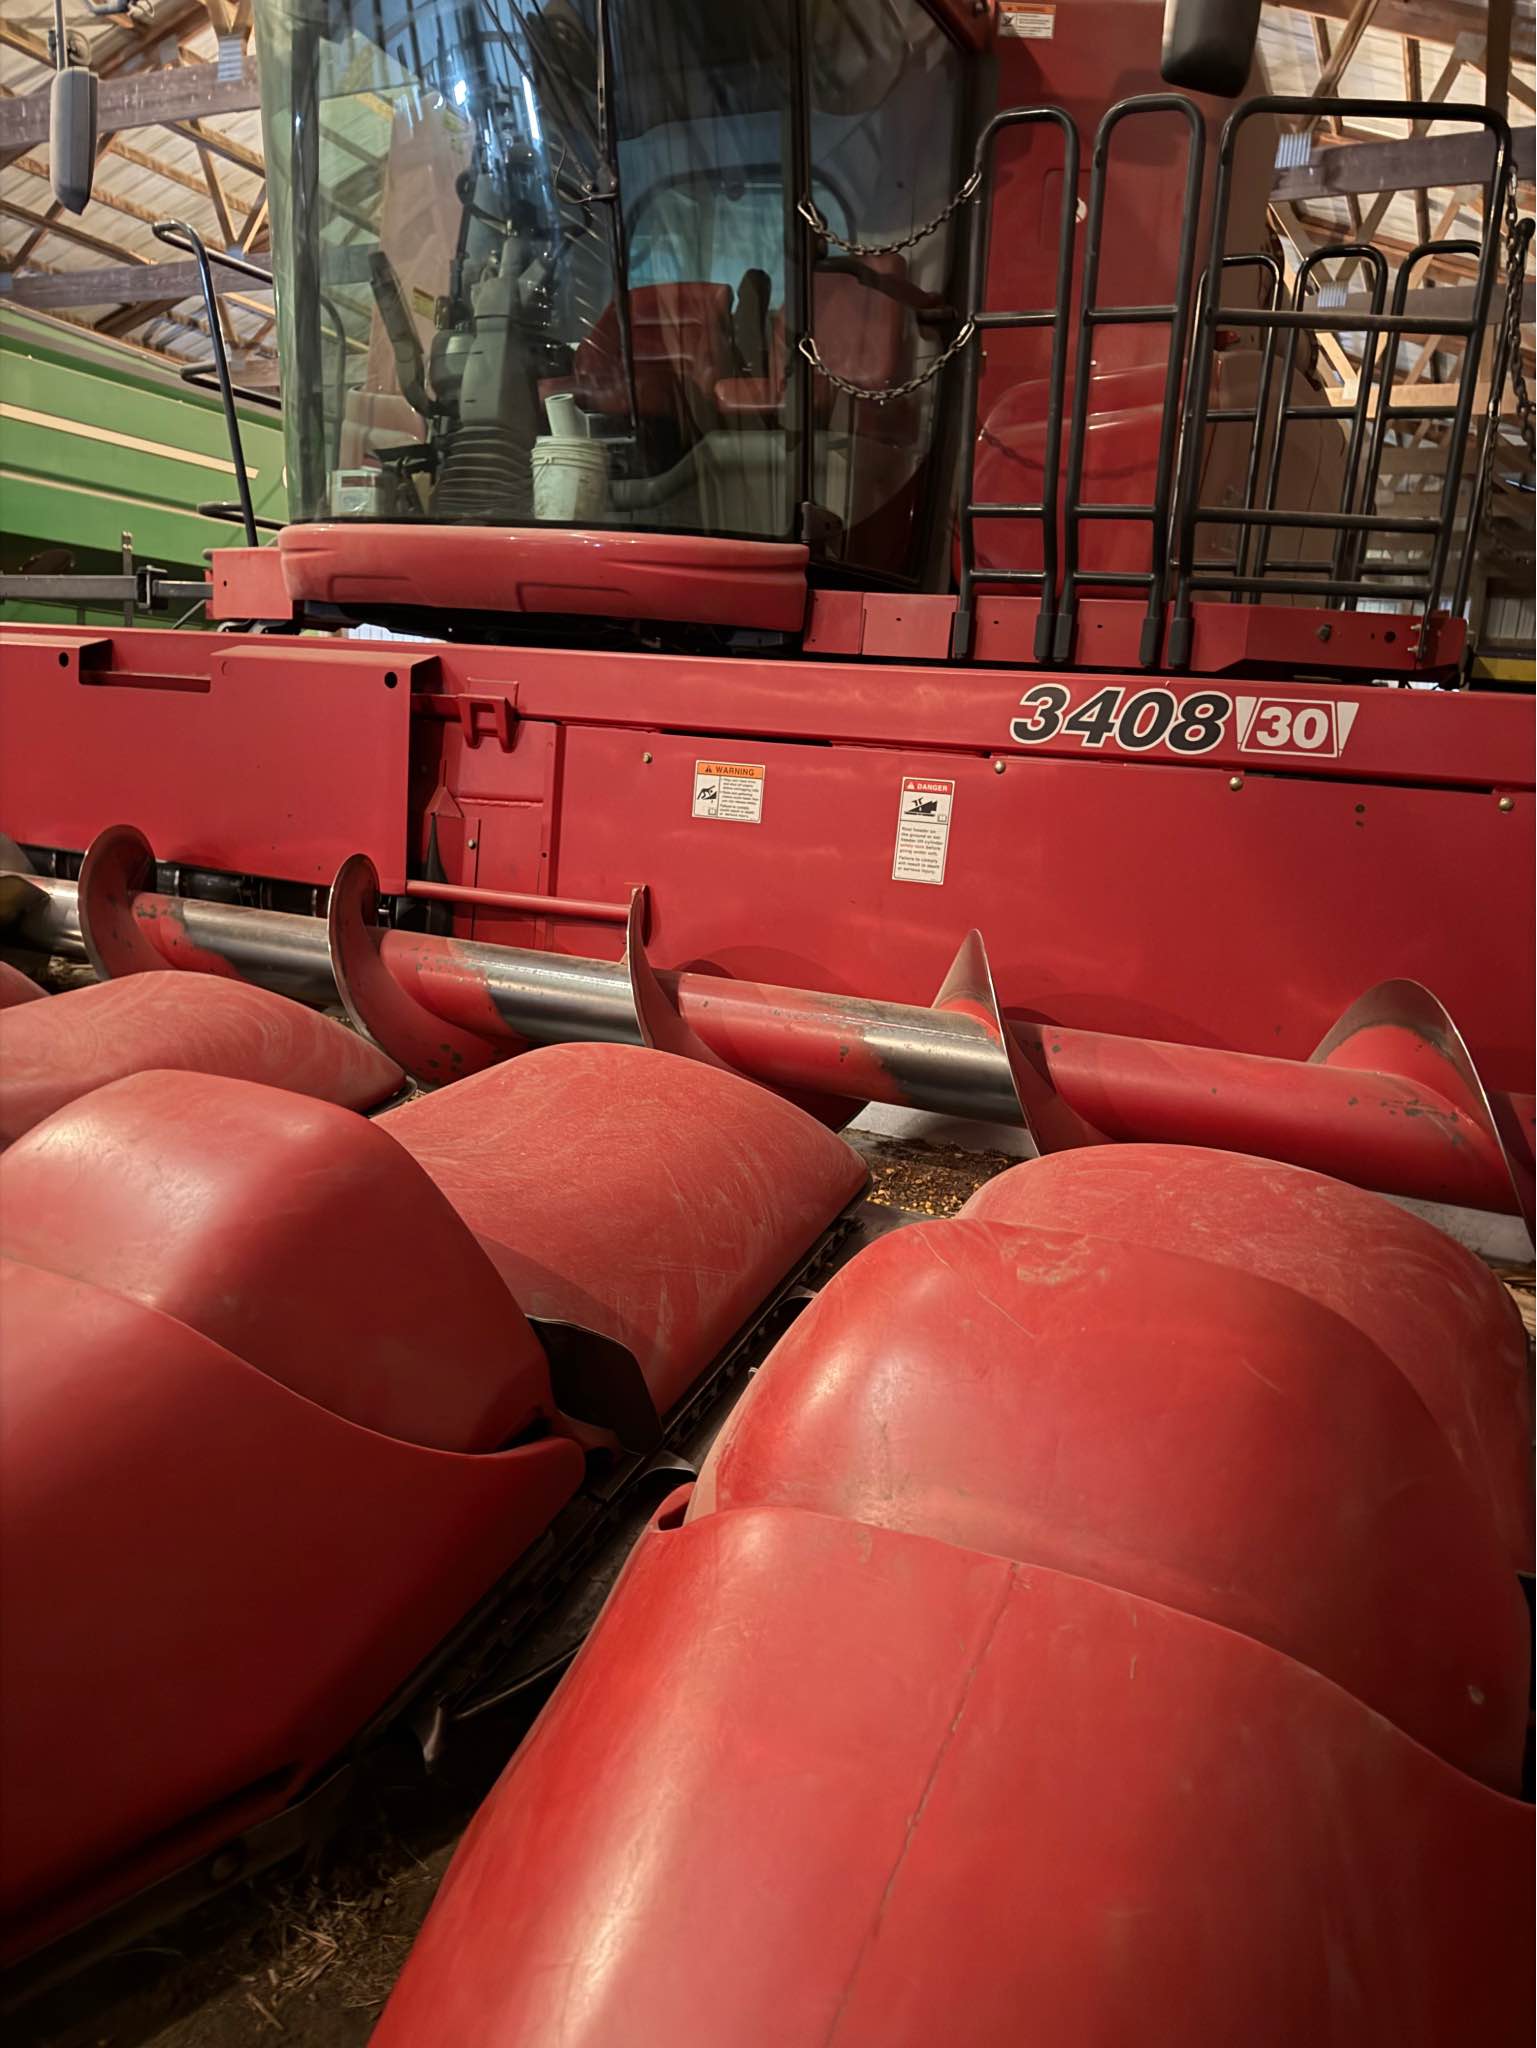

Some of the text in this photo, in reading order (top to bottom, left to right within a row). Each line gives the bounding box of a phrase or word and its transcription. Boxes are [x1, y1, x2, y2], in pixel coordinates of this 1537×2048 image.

[1010, 683, 1328, 755] 3408 30
[715, 766, 755, 776] WARNING
[917, 783, 948, 791] DANGER
